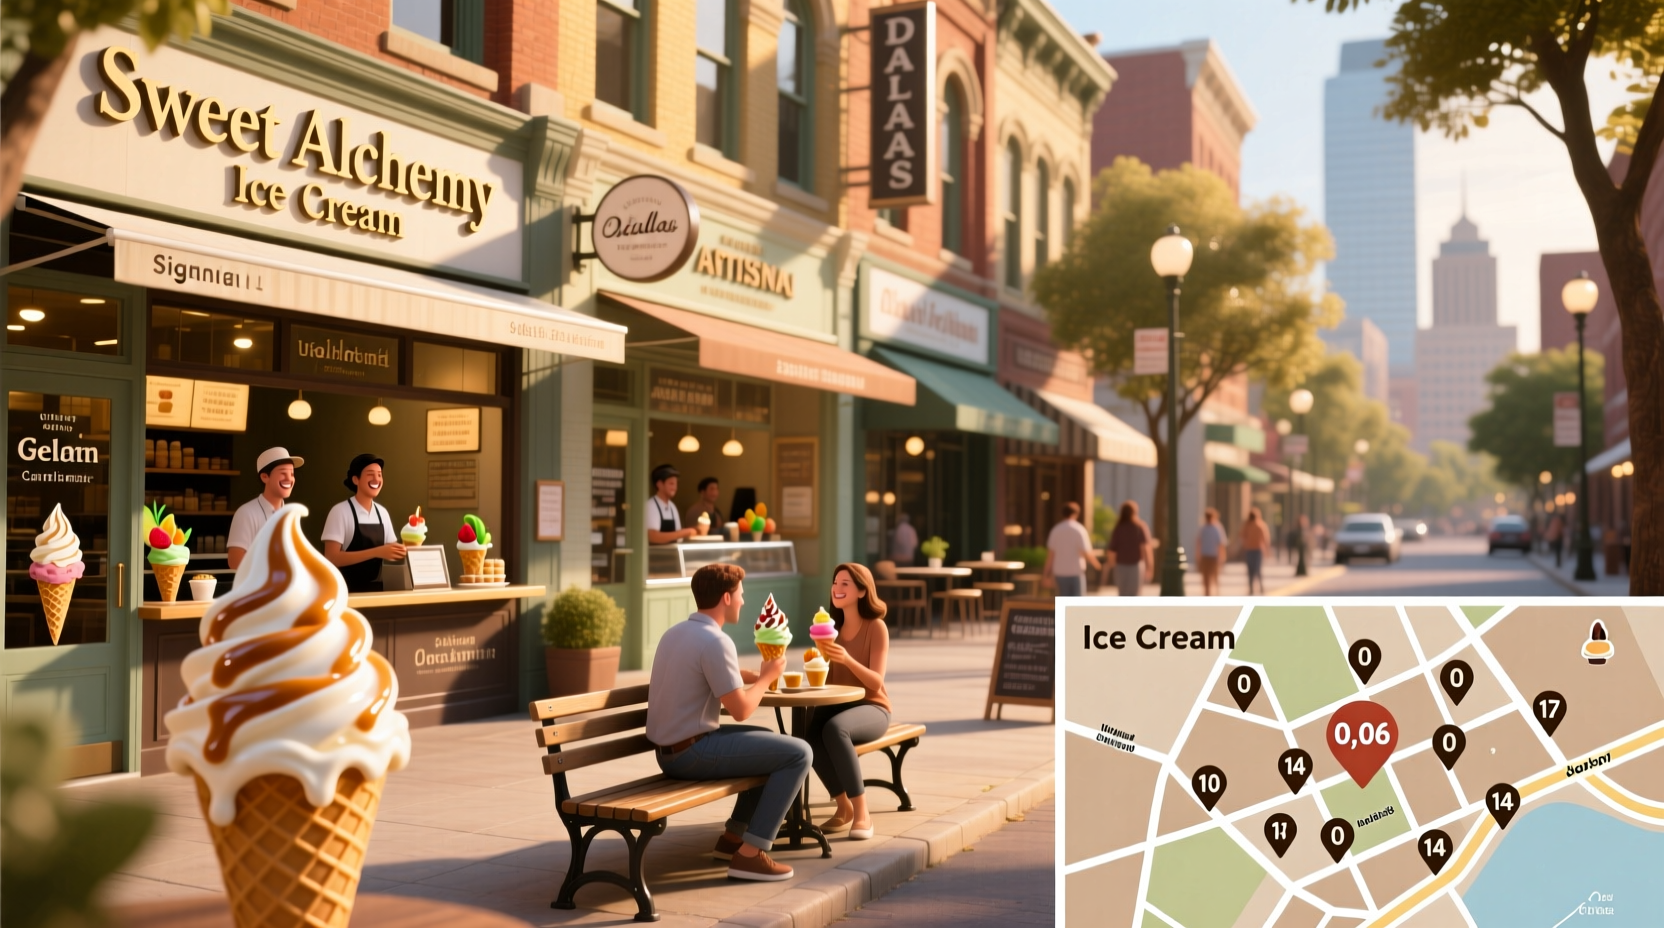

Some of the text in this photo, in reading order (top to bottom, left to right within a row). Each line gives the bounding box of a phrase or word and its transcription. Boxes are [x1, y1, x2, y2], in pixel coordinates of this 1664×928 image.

[98, 45, 497, 233] Sweet Alchemy
[883, 17, 915, 190] DALAAS
[233, 164, 404, 239] Ice Cream
